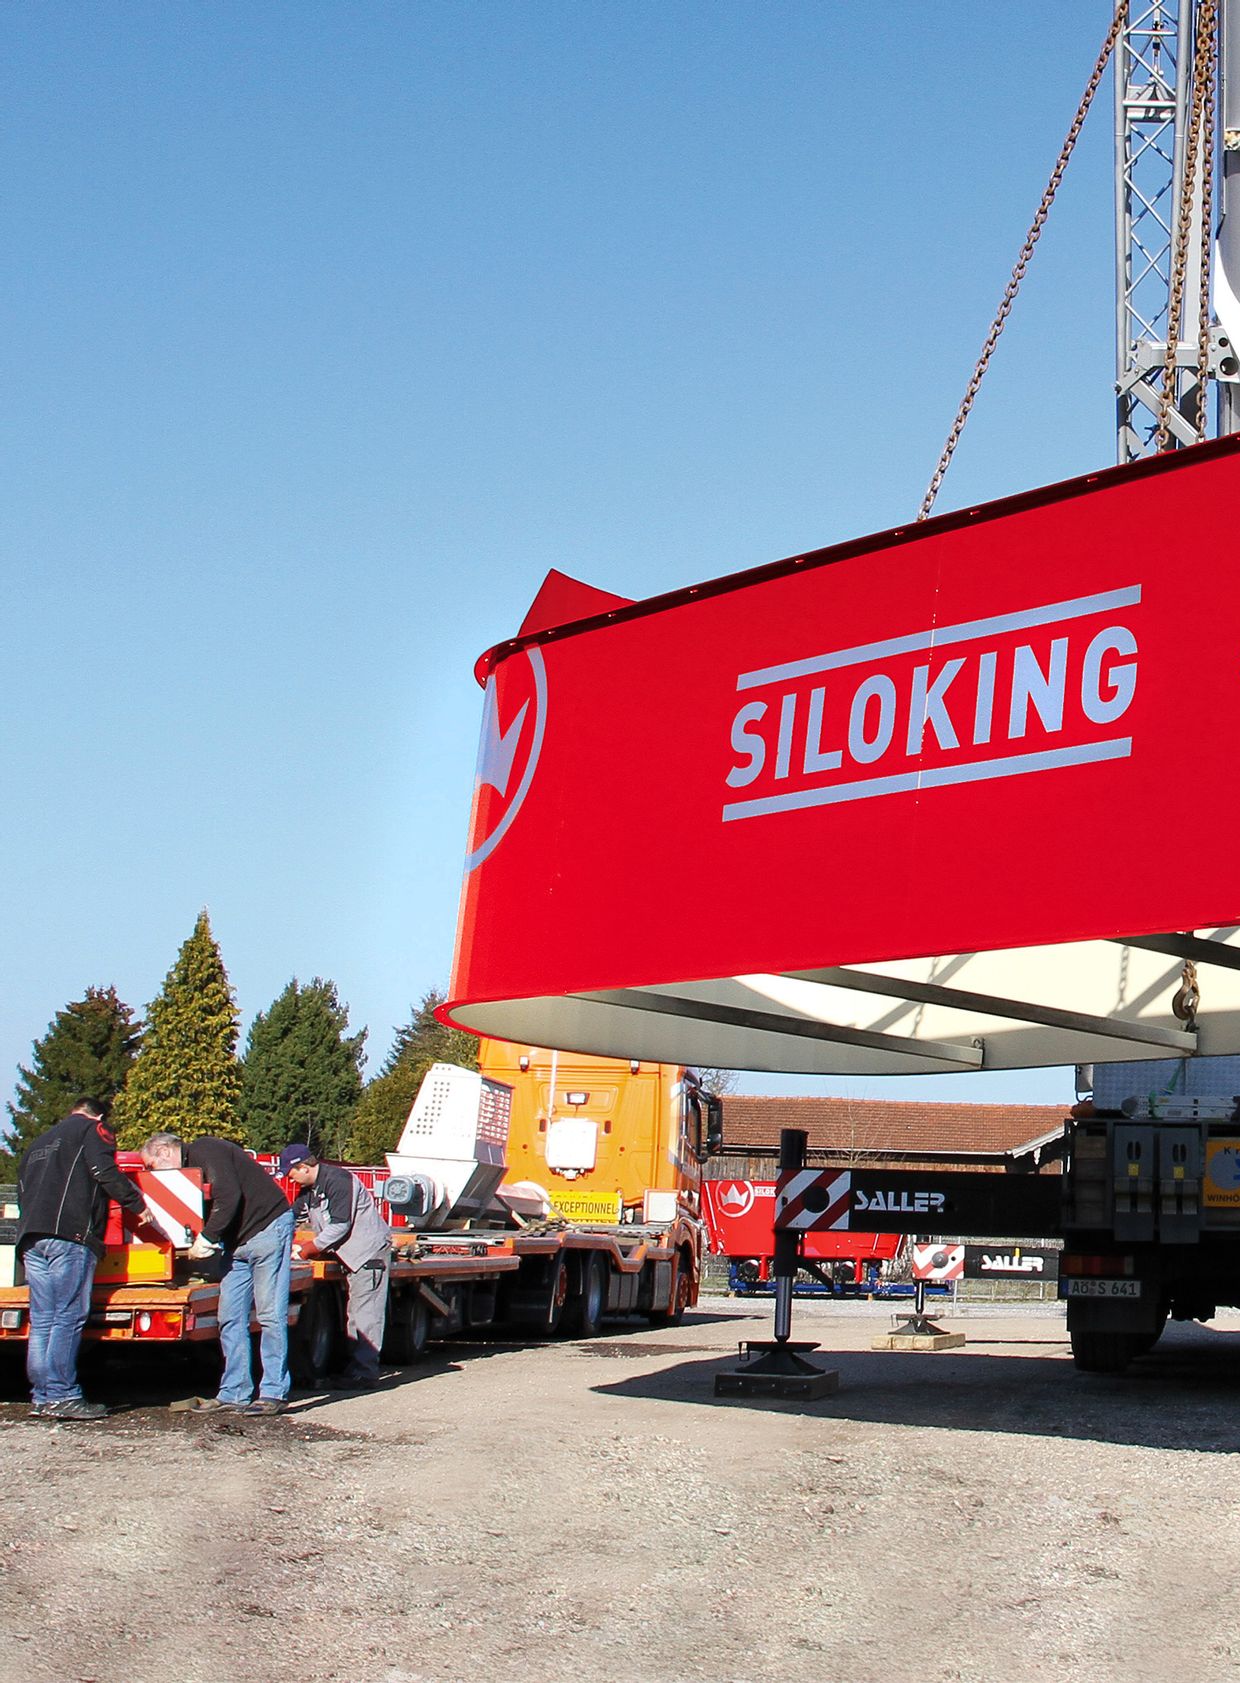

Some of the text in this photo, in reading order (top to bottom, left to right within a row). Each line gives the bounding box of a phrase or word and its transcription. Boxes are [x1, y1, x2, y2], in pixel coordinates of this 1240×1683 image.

[725, 625, 1139, 789] SILOKING
[554, 1201, 617, 1215] EXCEPTIONNEL
[854, 1190, 945, 1213] SALLER
[981, 1254, 1044, 1272] SALLER
[1098, 1282, 1106, 1295] S
[1111, 1282, 1137, 1296] 641
